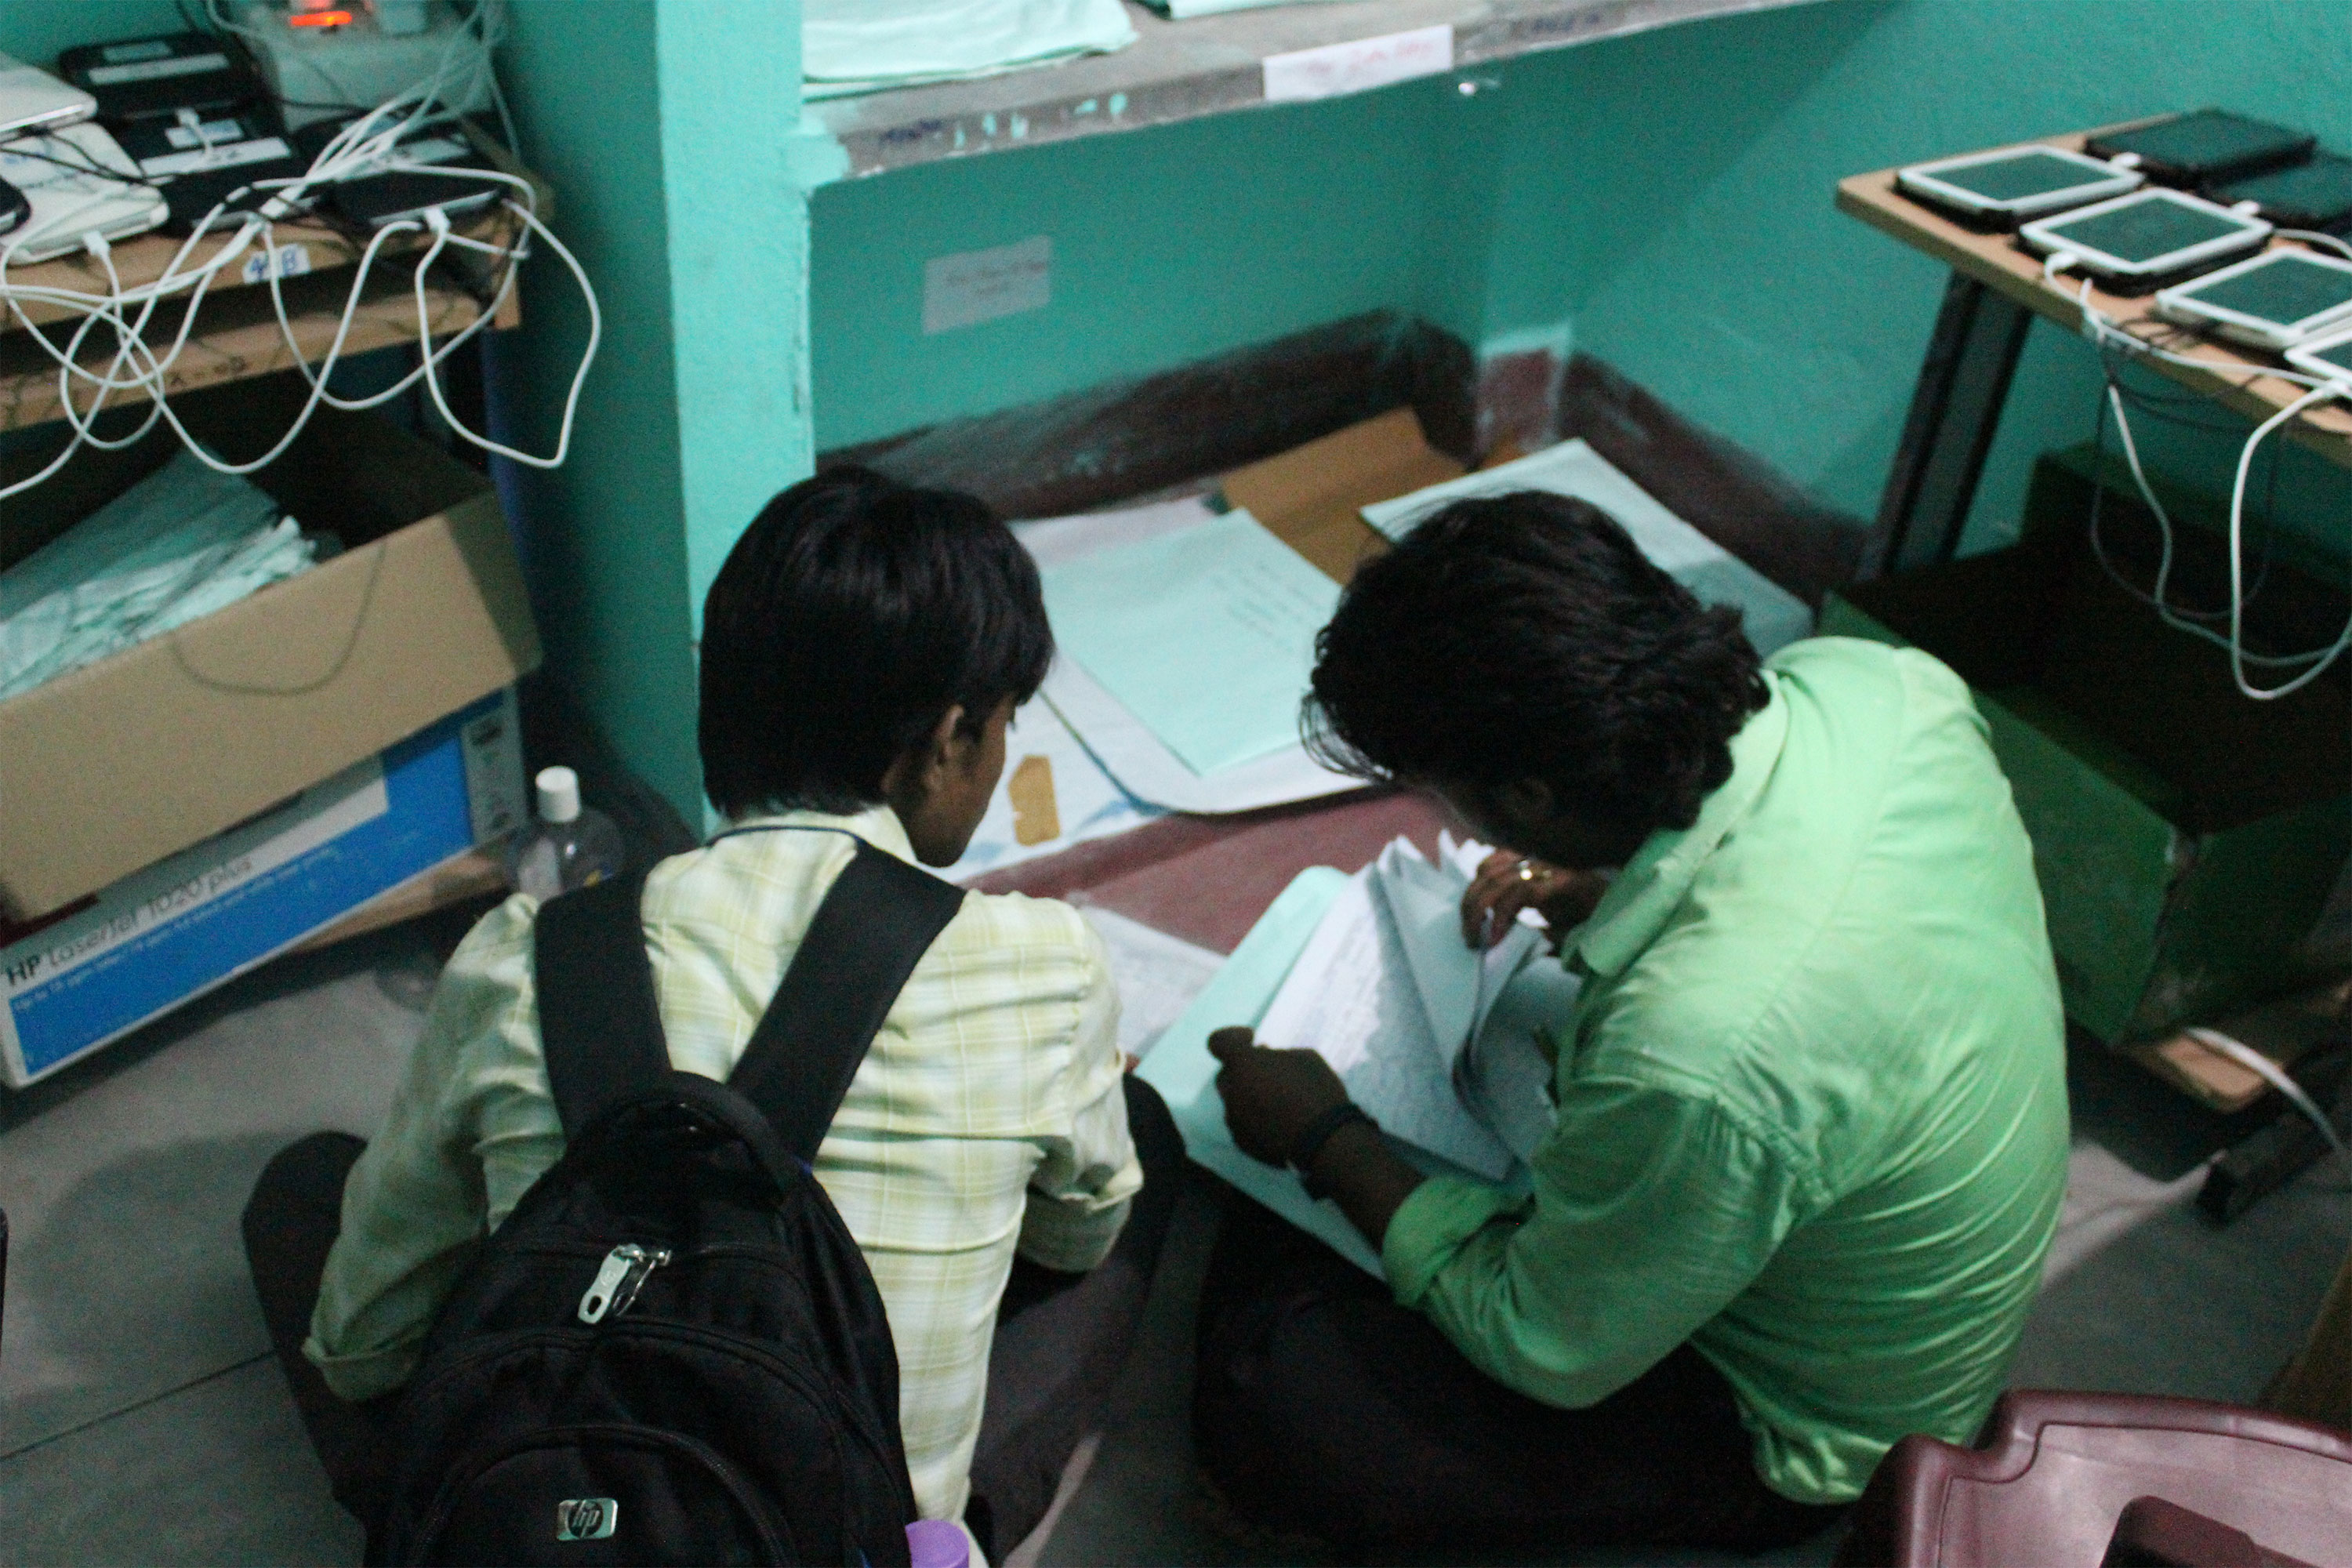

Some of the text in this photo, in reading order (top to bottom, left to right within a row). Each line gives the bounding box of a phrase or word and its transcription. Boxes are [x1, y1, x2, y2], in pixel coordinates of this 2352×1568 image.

[6, 954, 42, 986] HP
[48, 910, 140, 967] LaserJet
[147, 880, 204, 917] 1020
[205, 855, 253, 892] plus
[569, 1499, 601, 1537] hp
